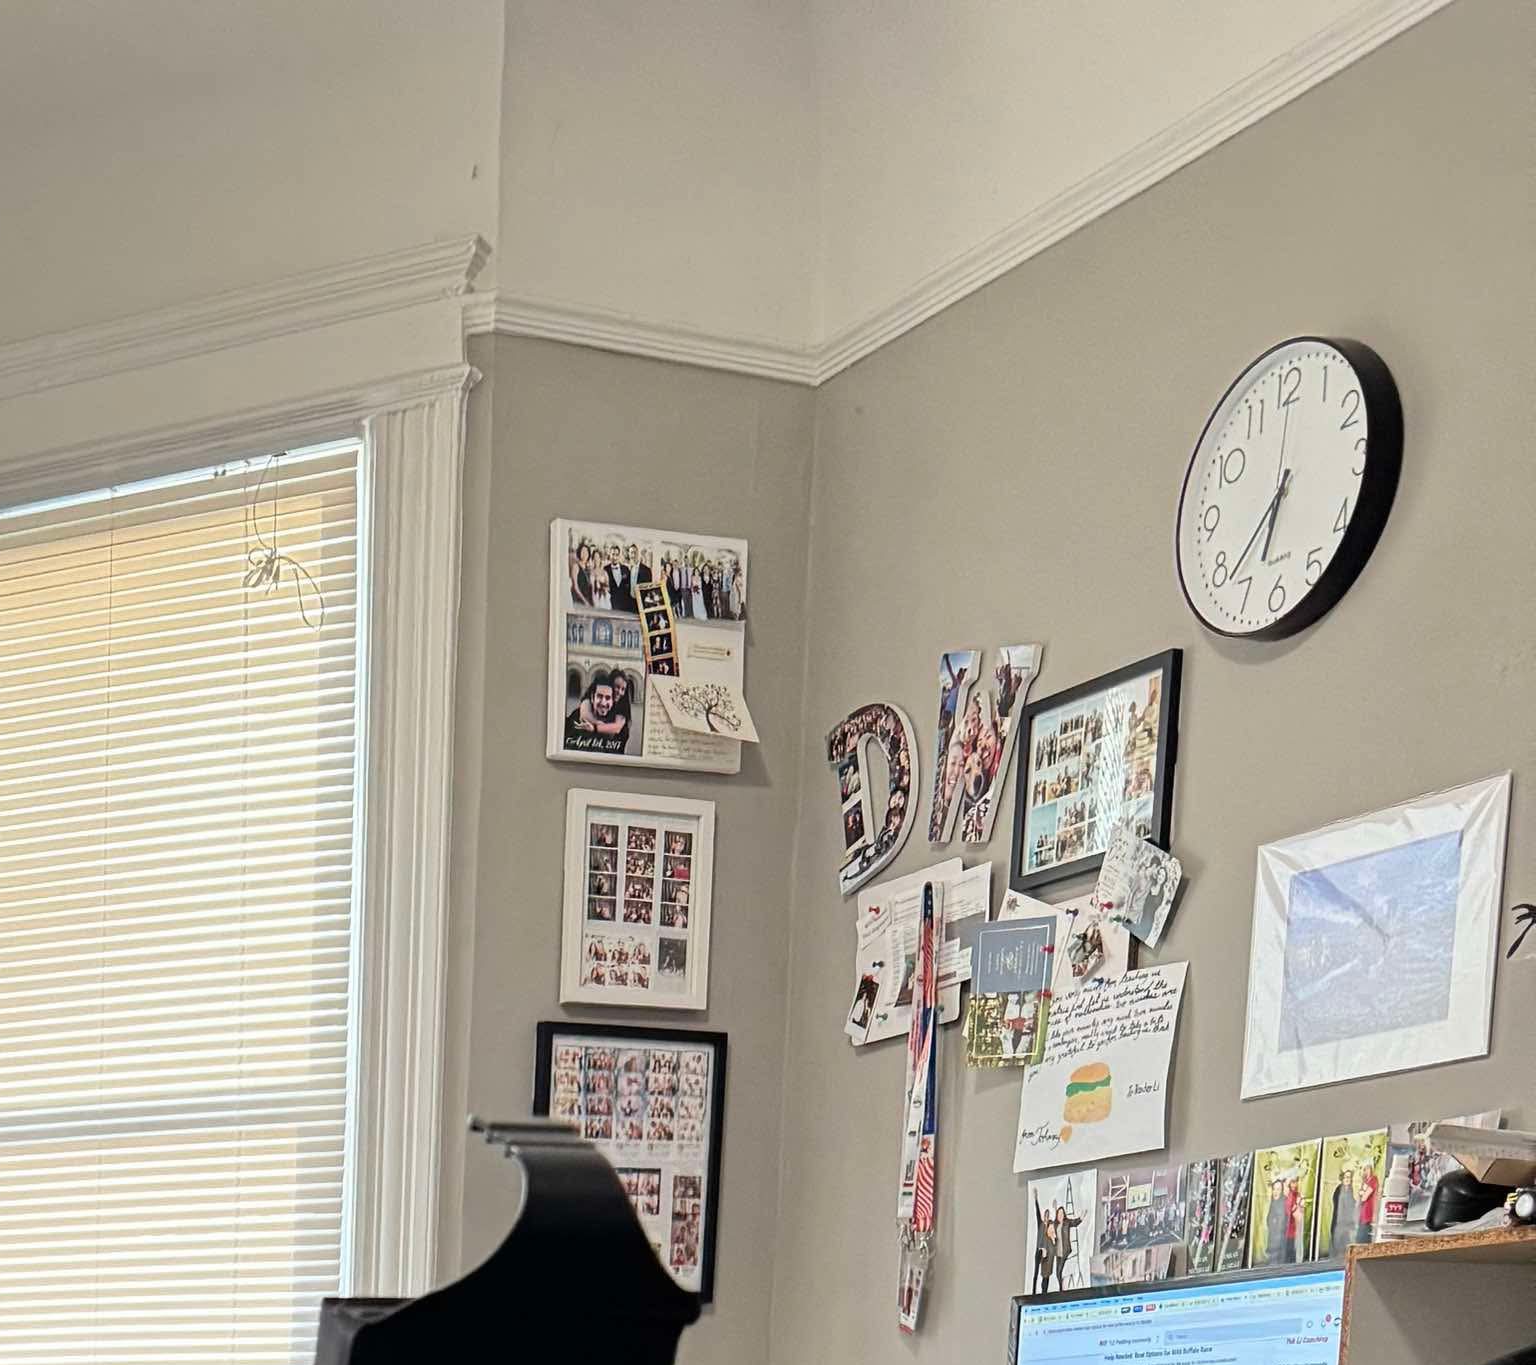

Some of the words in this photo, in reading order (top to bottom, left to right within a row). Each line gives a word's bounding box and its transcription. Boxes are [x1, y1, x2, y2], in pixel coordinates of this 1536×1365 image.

[1277, 367, 1302, 410] 12
[1321, 365, 1328, 402] 1
[1246, 399, 1265, 440] 11
[1340, 389, 1361, 431] 2
[1218, 448, 1246, 489] 10
[1203, 504, 1221, 543] 9
[1332, 497, 1349, 534] 4
[1212, 551, 1228, 588] 8
[1304, 546, 1323, 587] 5
[1237, 575, 1253, 615] 7
[1267, 574, 1287, 613] 6
